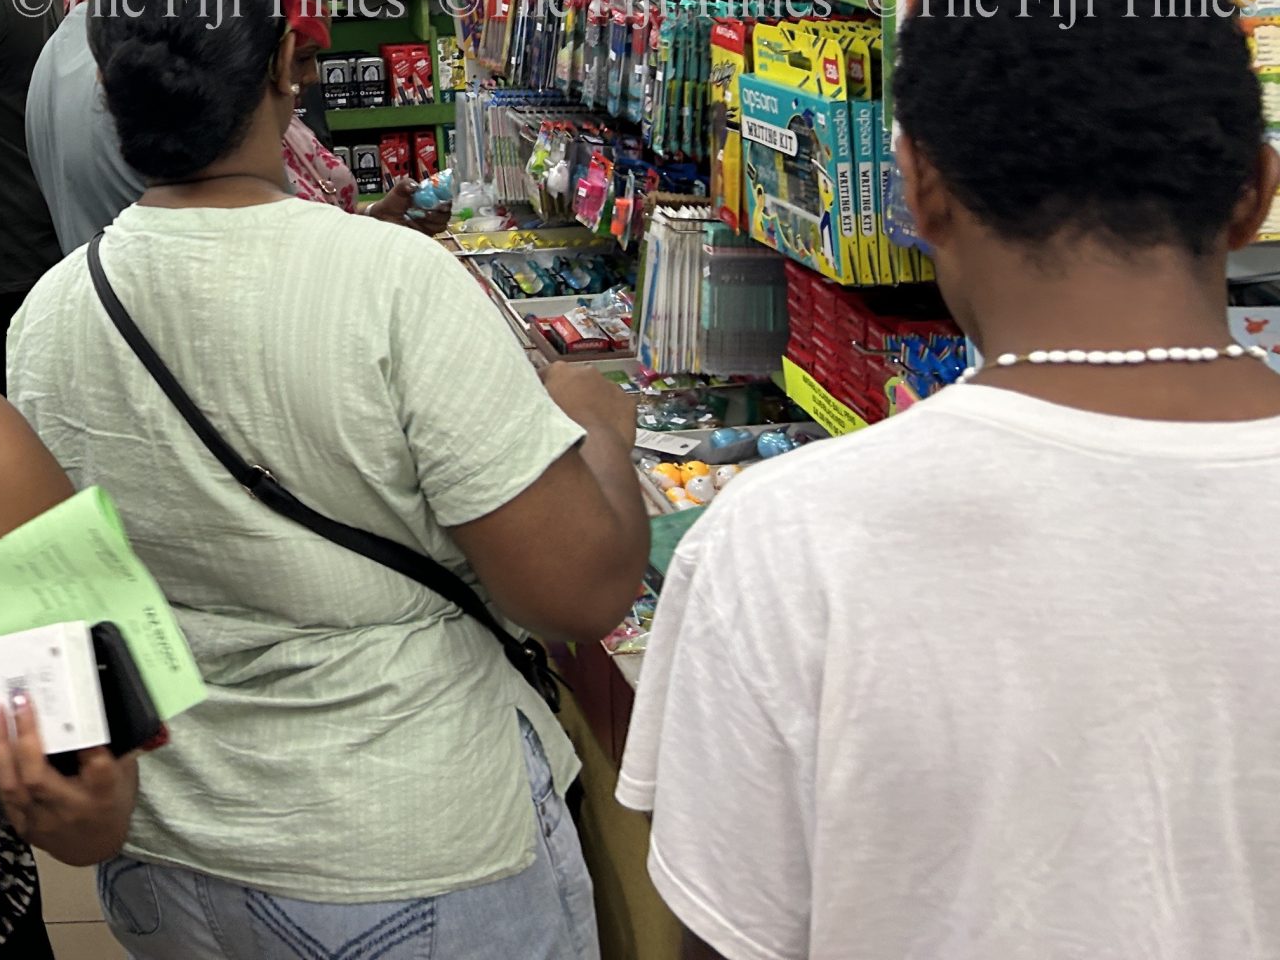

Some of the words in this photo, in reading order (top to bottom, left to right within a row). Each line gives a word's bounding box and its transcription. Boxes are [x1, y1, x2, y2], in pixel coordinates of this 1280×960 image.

[743, 87, 779, 116] apsara
[746, 121, 778, 147] WRITING
[779, 133, 794, 153] KIT
[836, 108, 850, 157] apsara
[858, 108, 871, 156] apsara
[838, 169, 852, 213] WRITING
[860, 169, 872, 213] WRITING
[842, 214, 852, 234] KIT
[862, 214, 872, 234] KIT
